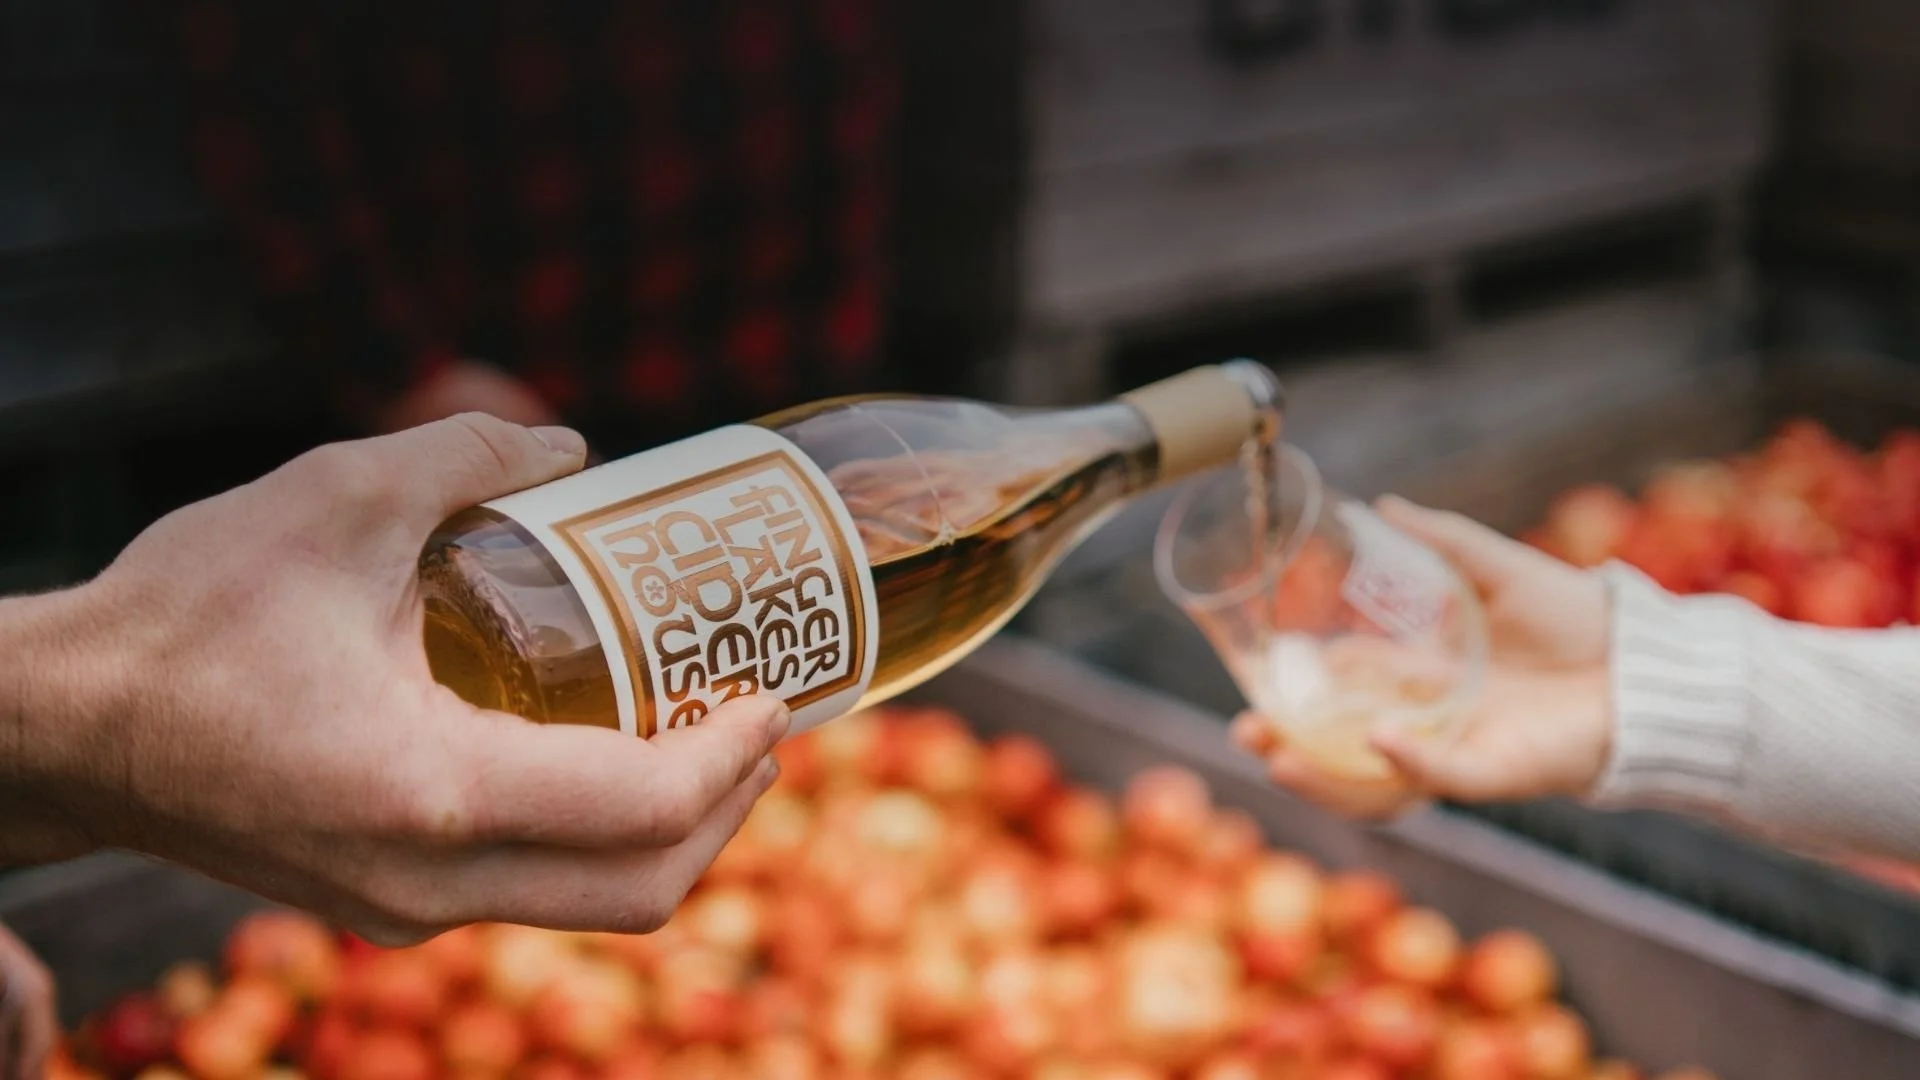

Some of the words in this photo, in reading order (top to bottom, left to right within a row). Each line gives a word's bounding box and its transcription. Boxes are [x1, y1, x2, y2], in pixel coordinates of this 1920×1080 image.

[654, 511, 759, 705] CIDER
[713, 504, 800, 690] LAKES
[730, 485, 840, 686] FINGER
